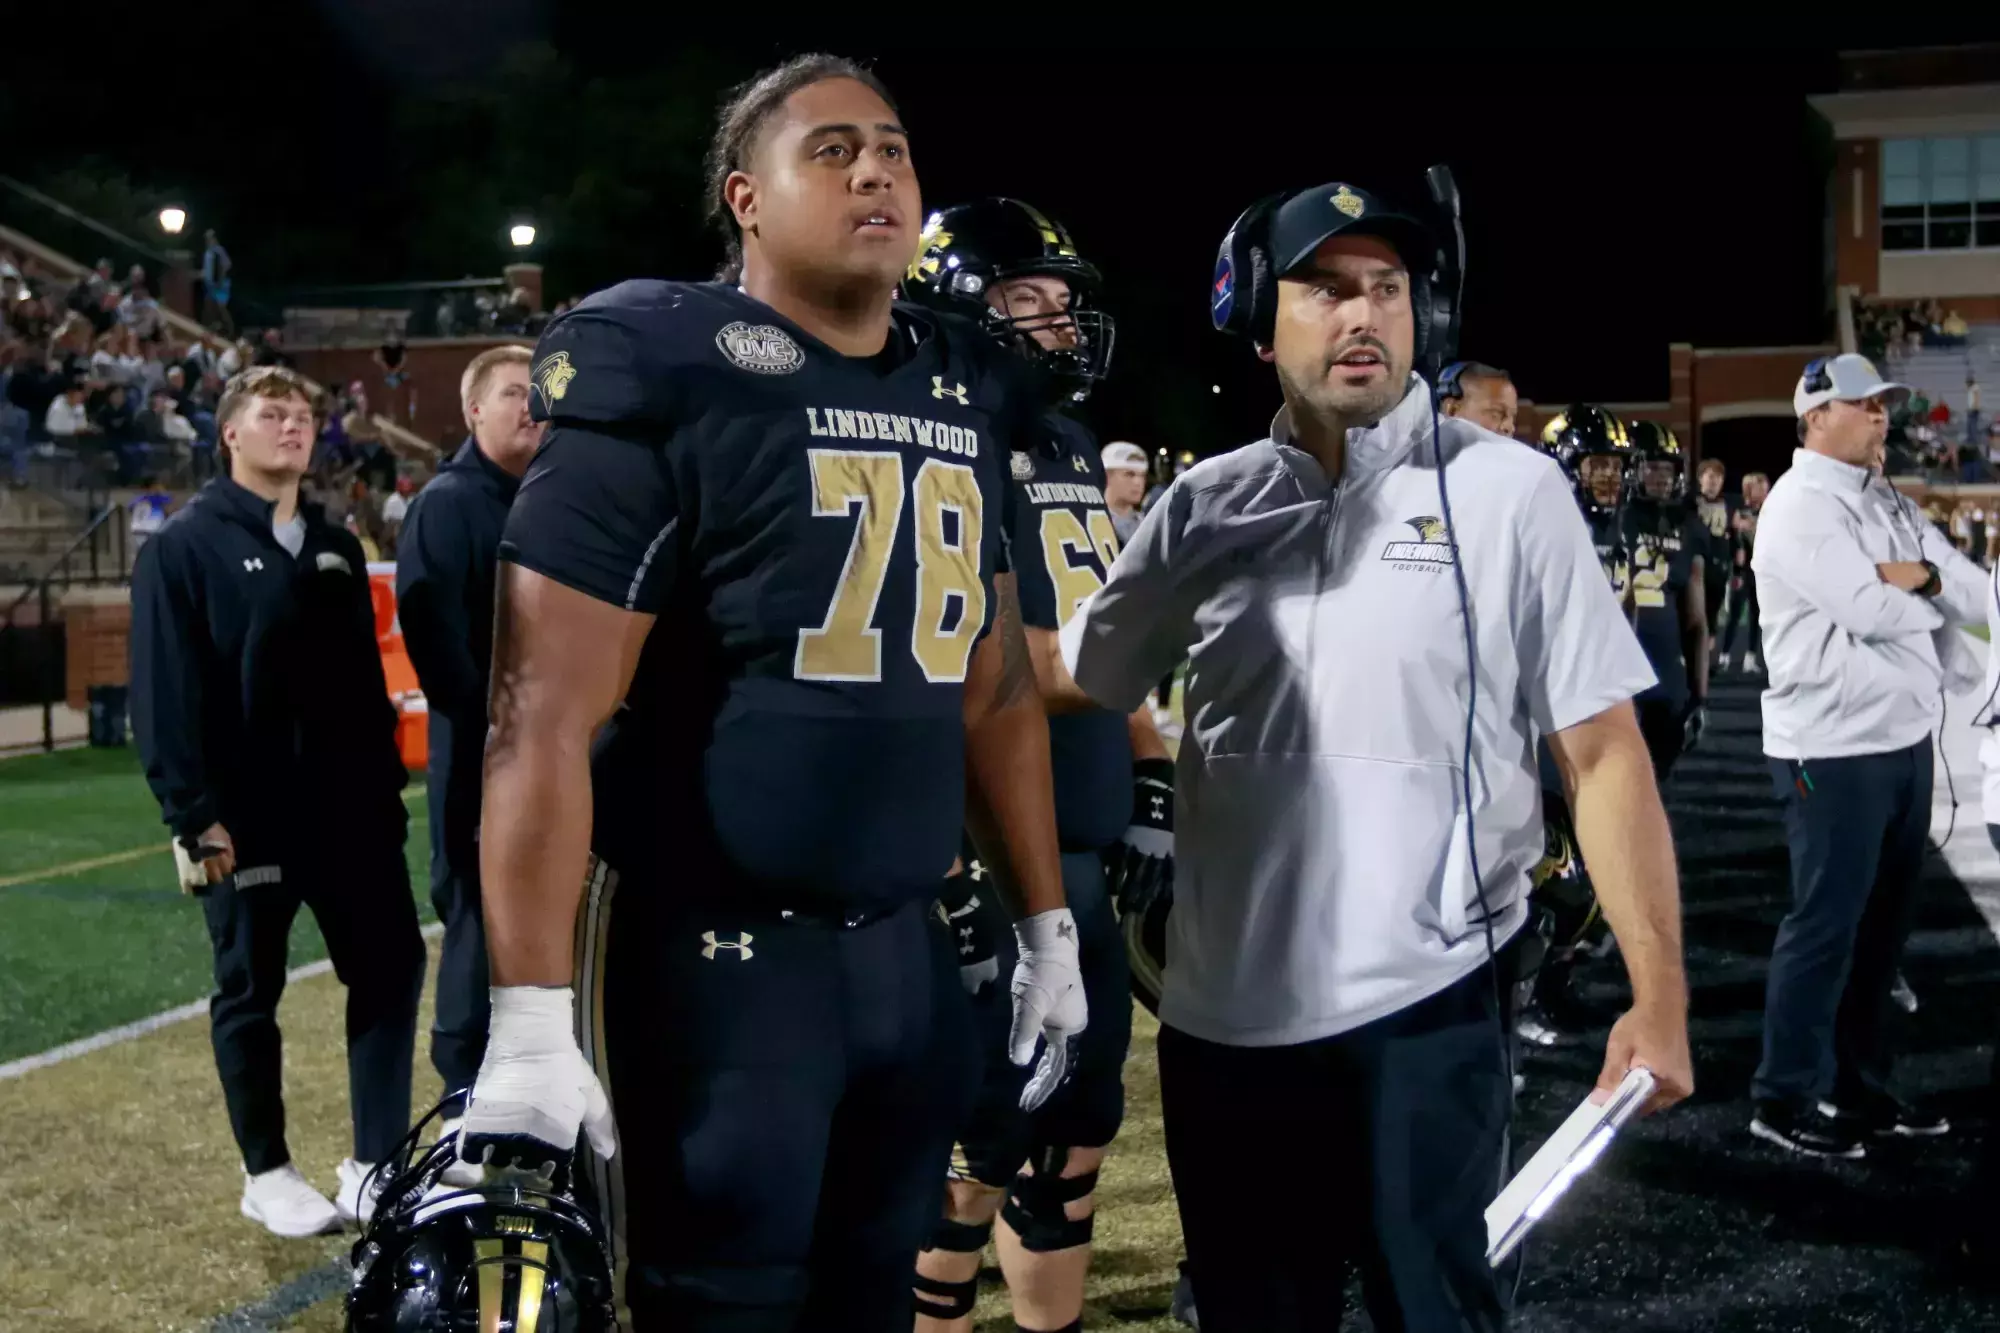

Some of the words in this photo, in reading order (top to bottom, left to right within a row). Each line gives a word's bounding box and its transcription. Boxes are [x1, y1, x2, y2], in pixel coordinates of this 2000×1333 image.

[737, 337, 787, 360] OVC
[806, 407, 978, 458] LINDENWOOD
[794, 449, 986, 683] 78
[1392, 563, 1444, 574] FOOTBALL
